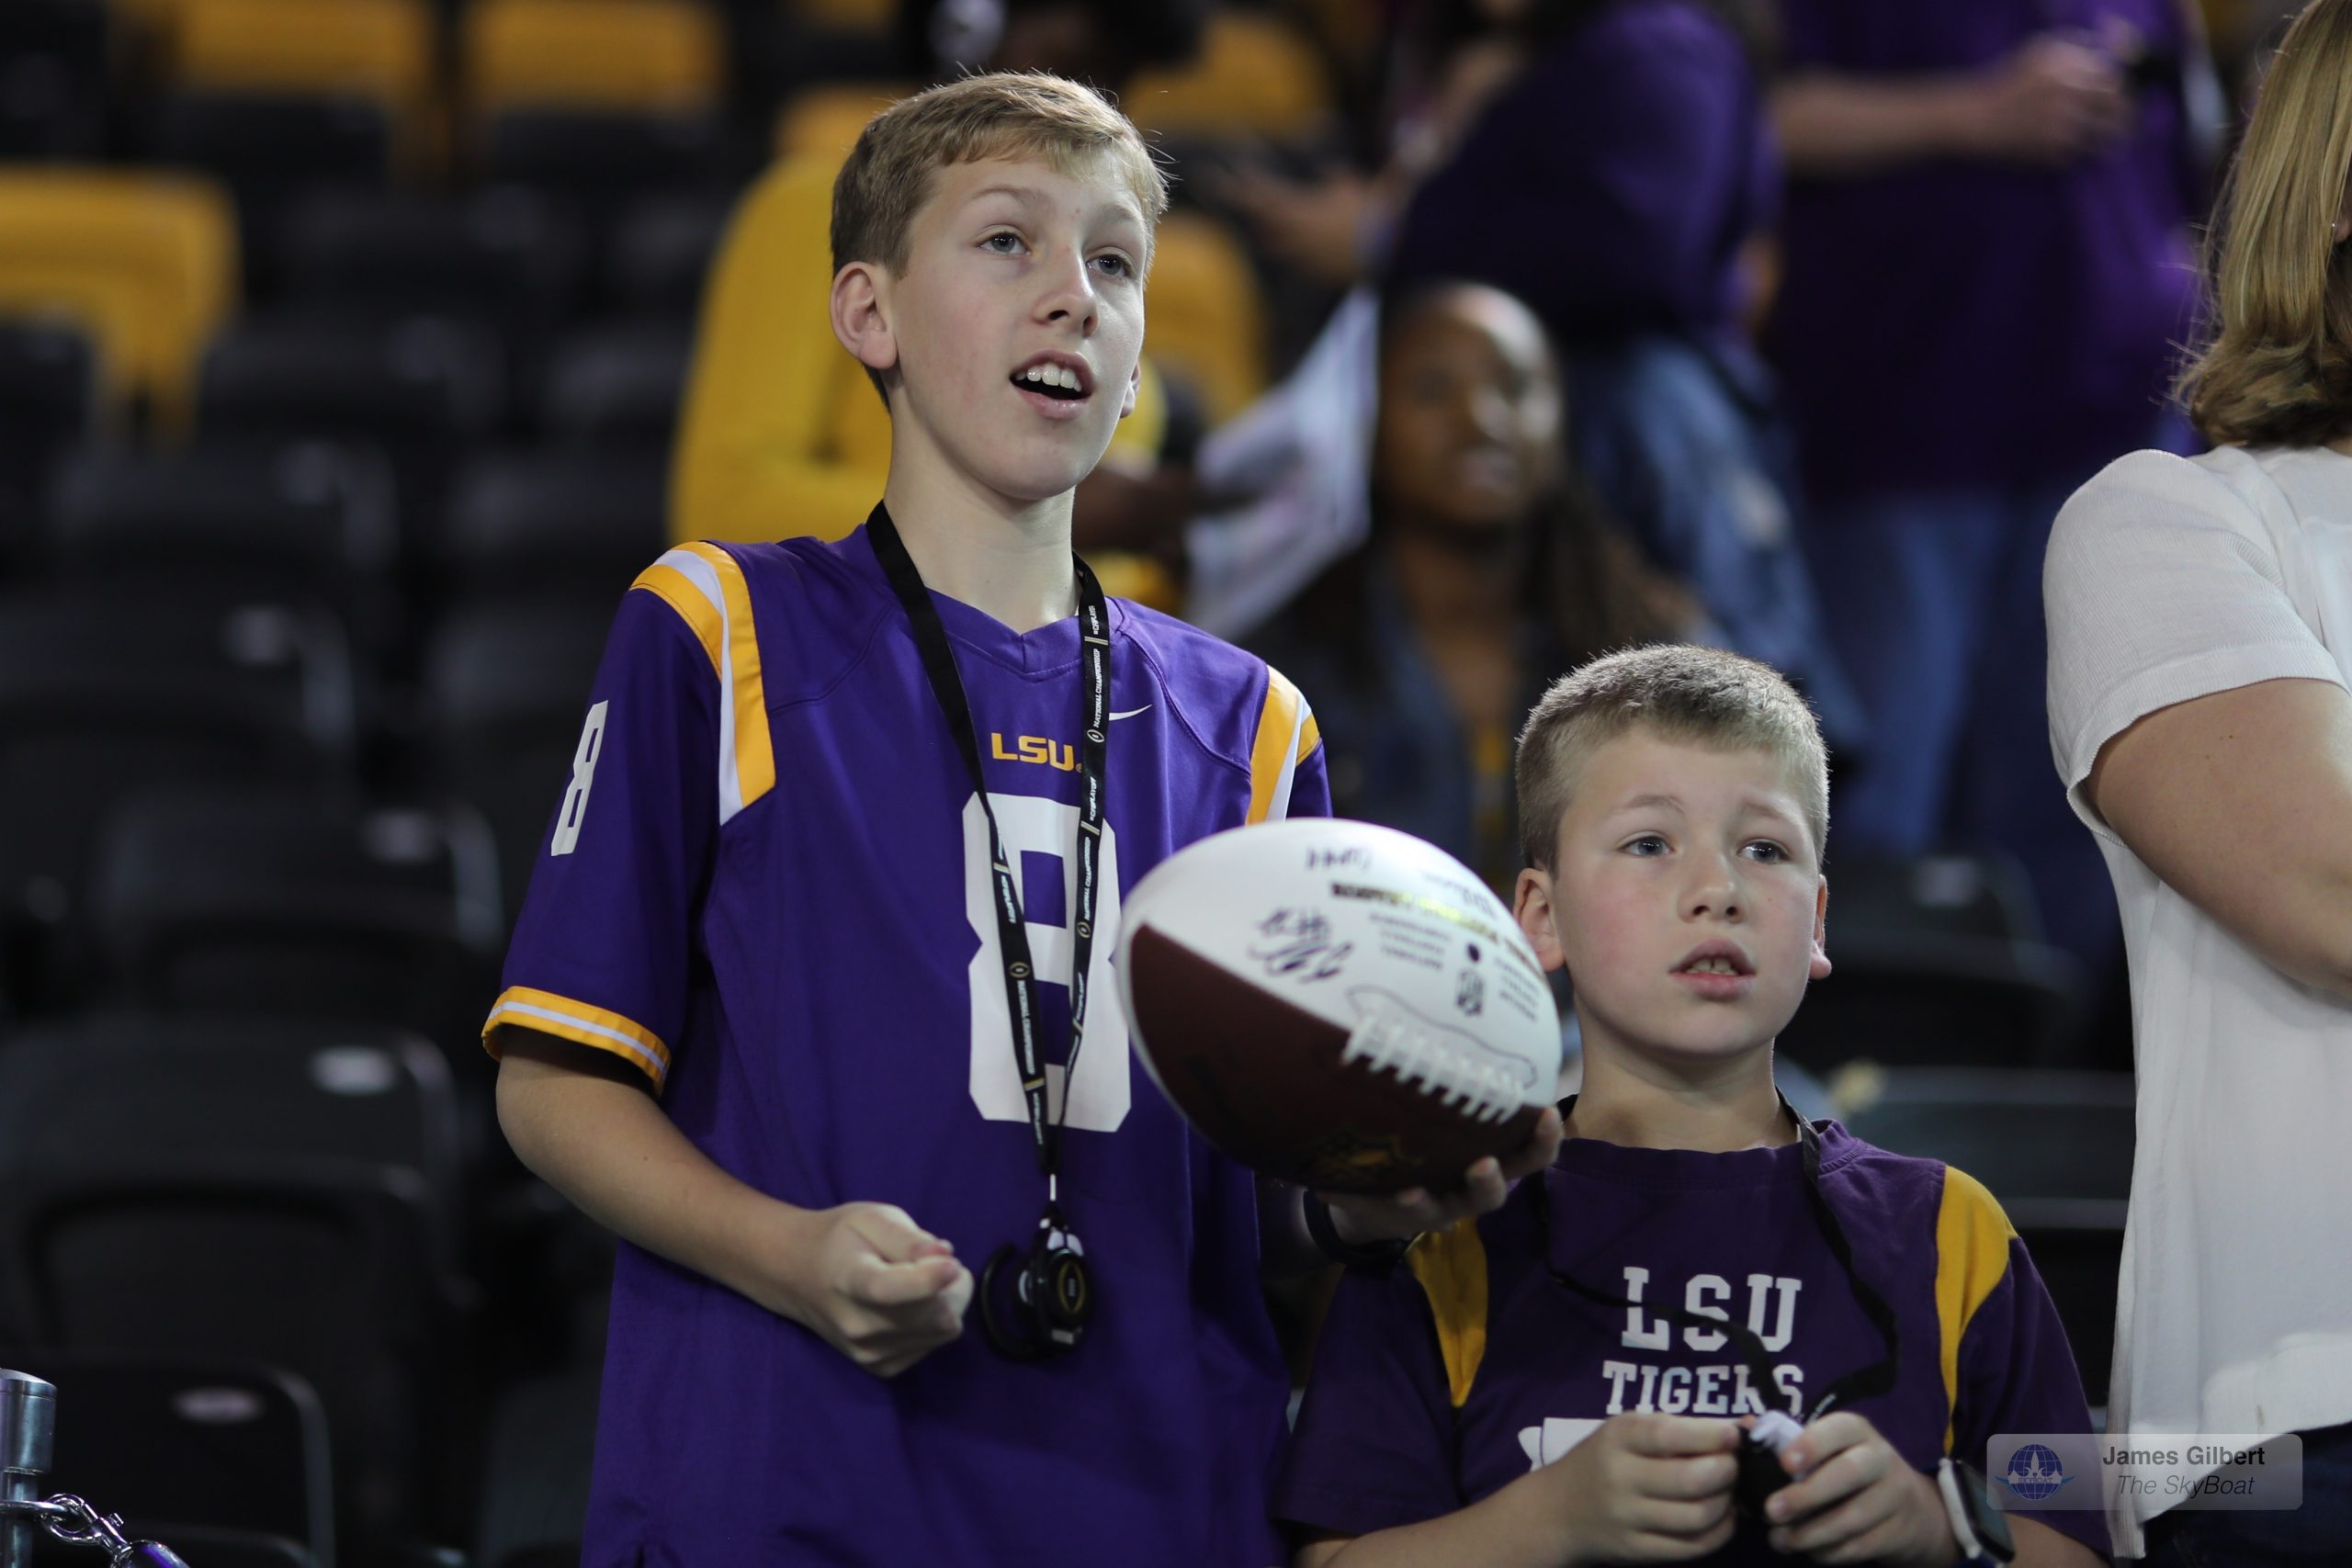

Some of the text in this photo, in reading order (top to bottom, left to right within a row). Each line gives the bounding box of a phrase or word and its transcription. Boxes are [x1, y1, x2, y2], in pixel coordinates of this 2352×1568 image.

[1093, 648, 1102, 728] NATIONAL CHAMPIONSHIP
[551, 700, 609, 857] 8
[990, 732, 1074, 772] LSU
[962, 791, 1132, 1134] 8
[1621, 1266, 1803, 1352] LSU
